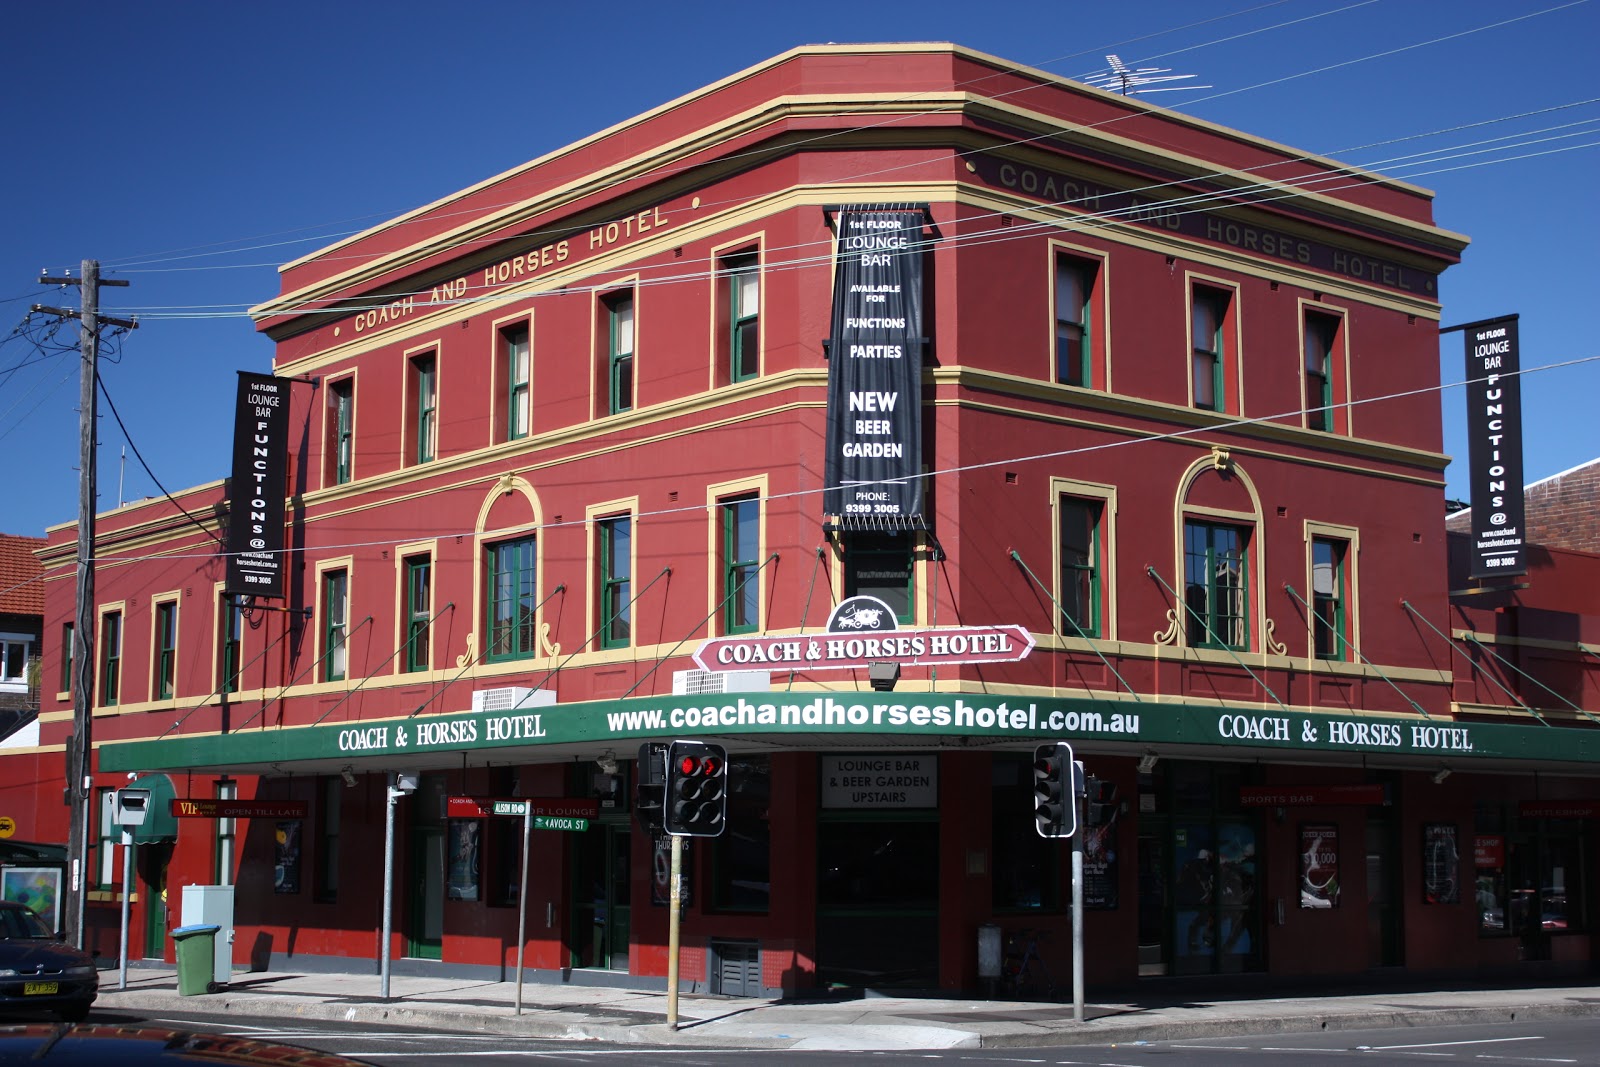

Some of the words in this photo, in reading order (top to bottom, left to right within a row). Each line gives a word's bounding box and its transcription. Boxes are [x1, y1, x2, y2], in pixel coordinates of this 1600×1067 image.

[850, 220, 864, 229] 1st
[866, 220, 902, 229] FLOOR
[1000, 164, 1101, 210] COACH
[1128, 199, 1182, 230] AND
[1206, 214, 1311, 264] HORSES
[1333, 253, 1411, 290] HOTEL
[846, 236, 908, 250] LOUNGE
[861, 254, 891, 267] BAR
[354, 296, 414, 333] COACH
[429, 277, 467, 306] AND
[484, 240, 570, 287] HORSES
[589, 206, 668, 250] HOTEL
[850, 284, 901, 293] AVAILABLE
[846, 318, 906, 329] FUNCTIONS
[1476, 332, 1485, 341] 1st
[1486, 328, 1506, 339] FLOOR
[850, 345, 902, 358] PARTIES
[1474, 340, 1510, 358] LOUNGE
[1484, 356, 1501, 370] BAR
[250, 383, 260, 391] 1st
[260, 384, 277, 393] FLOOR
[248, 393, 280, 407] LOUNGE
[849, 391, 898, 412] NEW
[255, 407, 272, 418] BAR
[855, 420, 891, 435] BEER
[842, 443, 903, 458] GARDEN
[855, 492, 890, 501] PHONE:
[845, 504, 872, 512] 9399
[874, 504, 900, 513] 3005
[1486, 558, 1500, 567] 9399
[1501, 557, 1515, 566] 3005
[244, 575, 258, 583] 9399
[718, 641, 802, 665] COACH
[807, 640, 822, 661] &
[827, 637, 927, 660] HORSES
[929, 633, 1012, 656] HOTEL
[606, 698, 1140, 734] www.coachandhorseshotel.com.au
[338, 727, 388, 751] COACH
[395, 726, 408, 747] &
[416, 719, 478, 746] HORSES
[486, 714, 546, 741] HOTEL
[1218, 714, 1291, 741] COACH
[1302, 719, 1317, 743] &
[1329, 720, 1402, 747] HORSES
[1411, 726, 1473, 750] HOTEL
[838, 760, 891, 772] LOUNGE
[895, 760, 920, 771] BAR
[829, 777, 838, 787] &
[843, 776, 871, 787] BEER
[876, 776, 930, 787] GARDEN
[852, 791, 907, 803] UPSTAIRS
[1240, 795, 1286, 804] SPORTS
[1290, 795, 1314, 803] BAR
[180, 802, 198, 815] VIP
[224, 808, 252, 816] OPEN
[255, 808, 275, 816] TILL
[278, 808, 303, 816] LATE
[494, 803, 511, 813] ALISON
[548, 807, 596, 816] LOUNGE
[1522, 809, 1593, 817] BOTTLESHOP
[549, 818, 573, 829] AVOCA
[575, 820, 585, 830] ST
